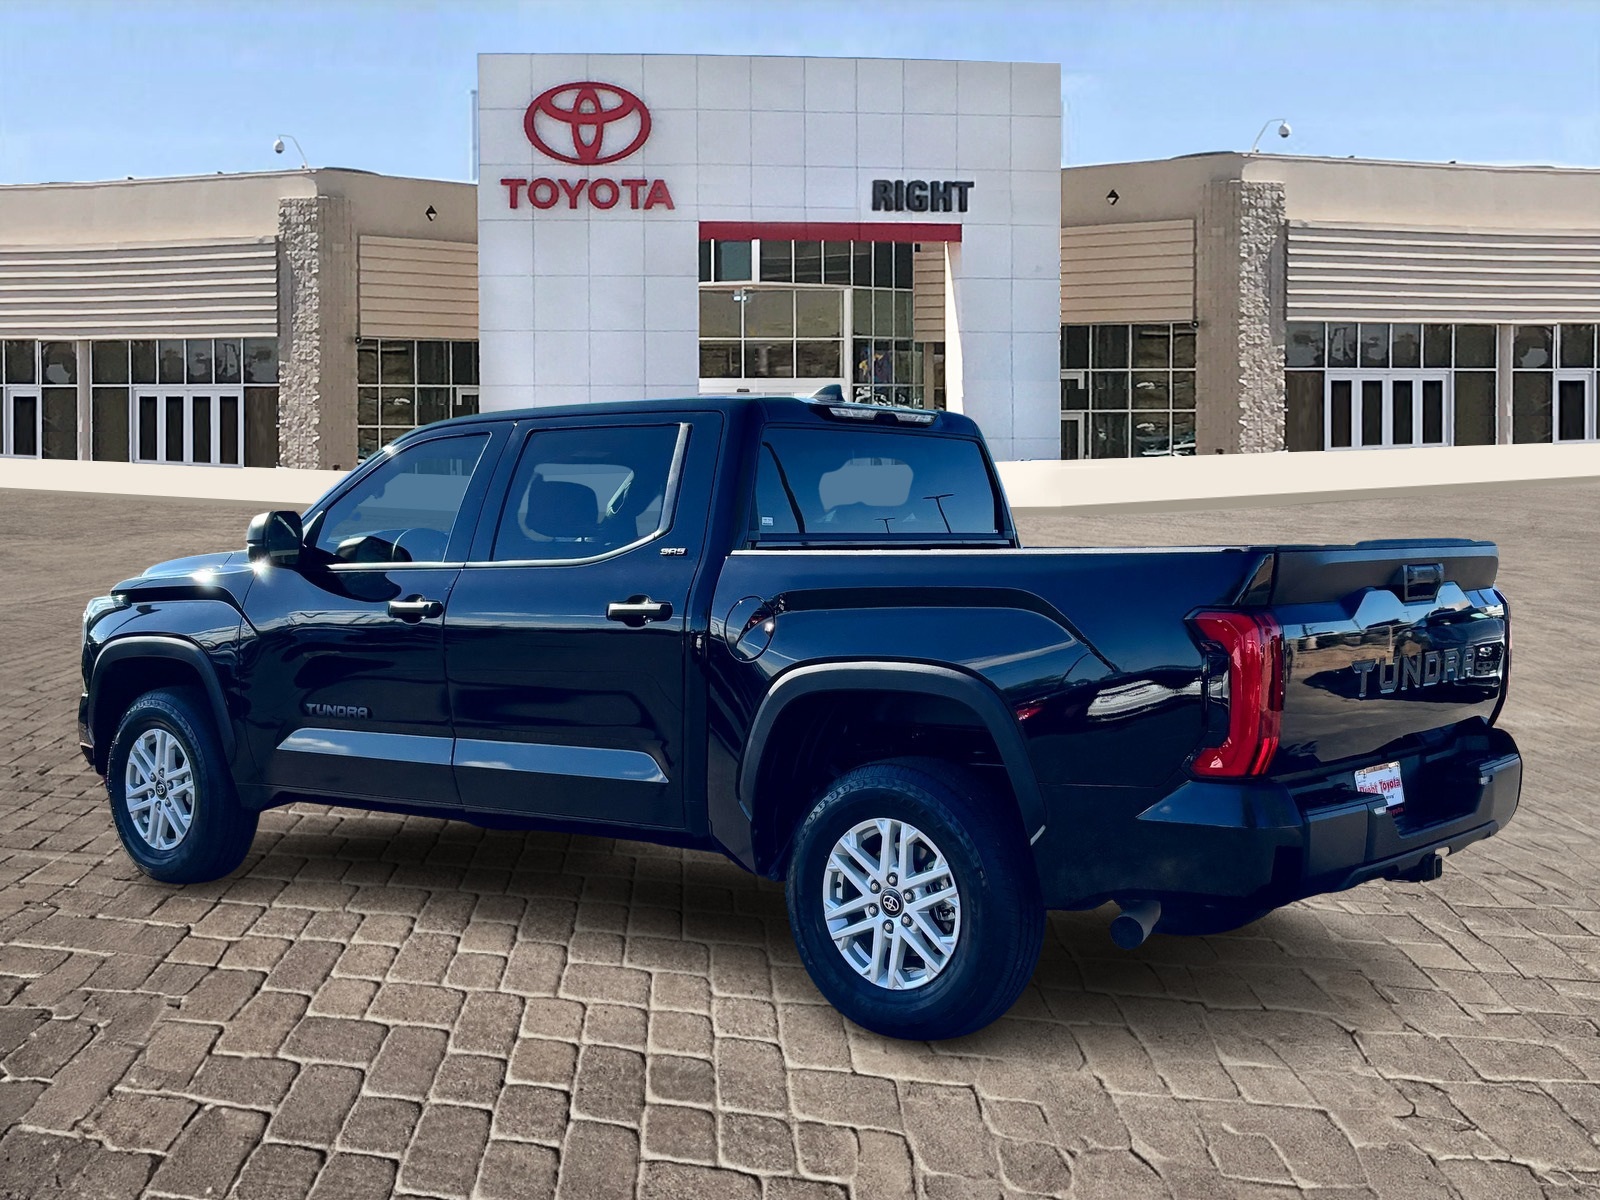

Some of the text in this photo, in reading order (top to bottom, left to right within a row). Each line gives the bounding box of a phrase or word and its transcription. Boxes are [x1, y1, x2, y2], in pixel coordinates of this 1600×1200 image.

[500, 178, 675, 210] TOYOTA
[872, 179, 975, 212] RIGHT
[660, 547, 687, 556] SR5
[1351, 646, 1475, 698] TUNDRA
[306, 703, 368, 719] TUNDRA
[1379, 777, 1401, 794] Toyota
